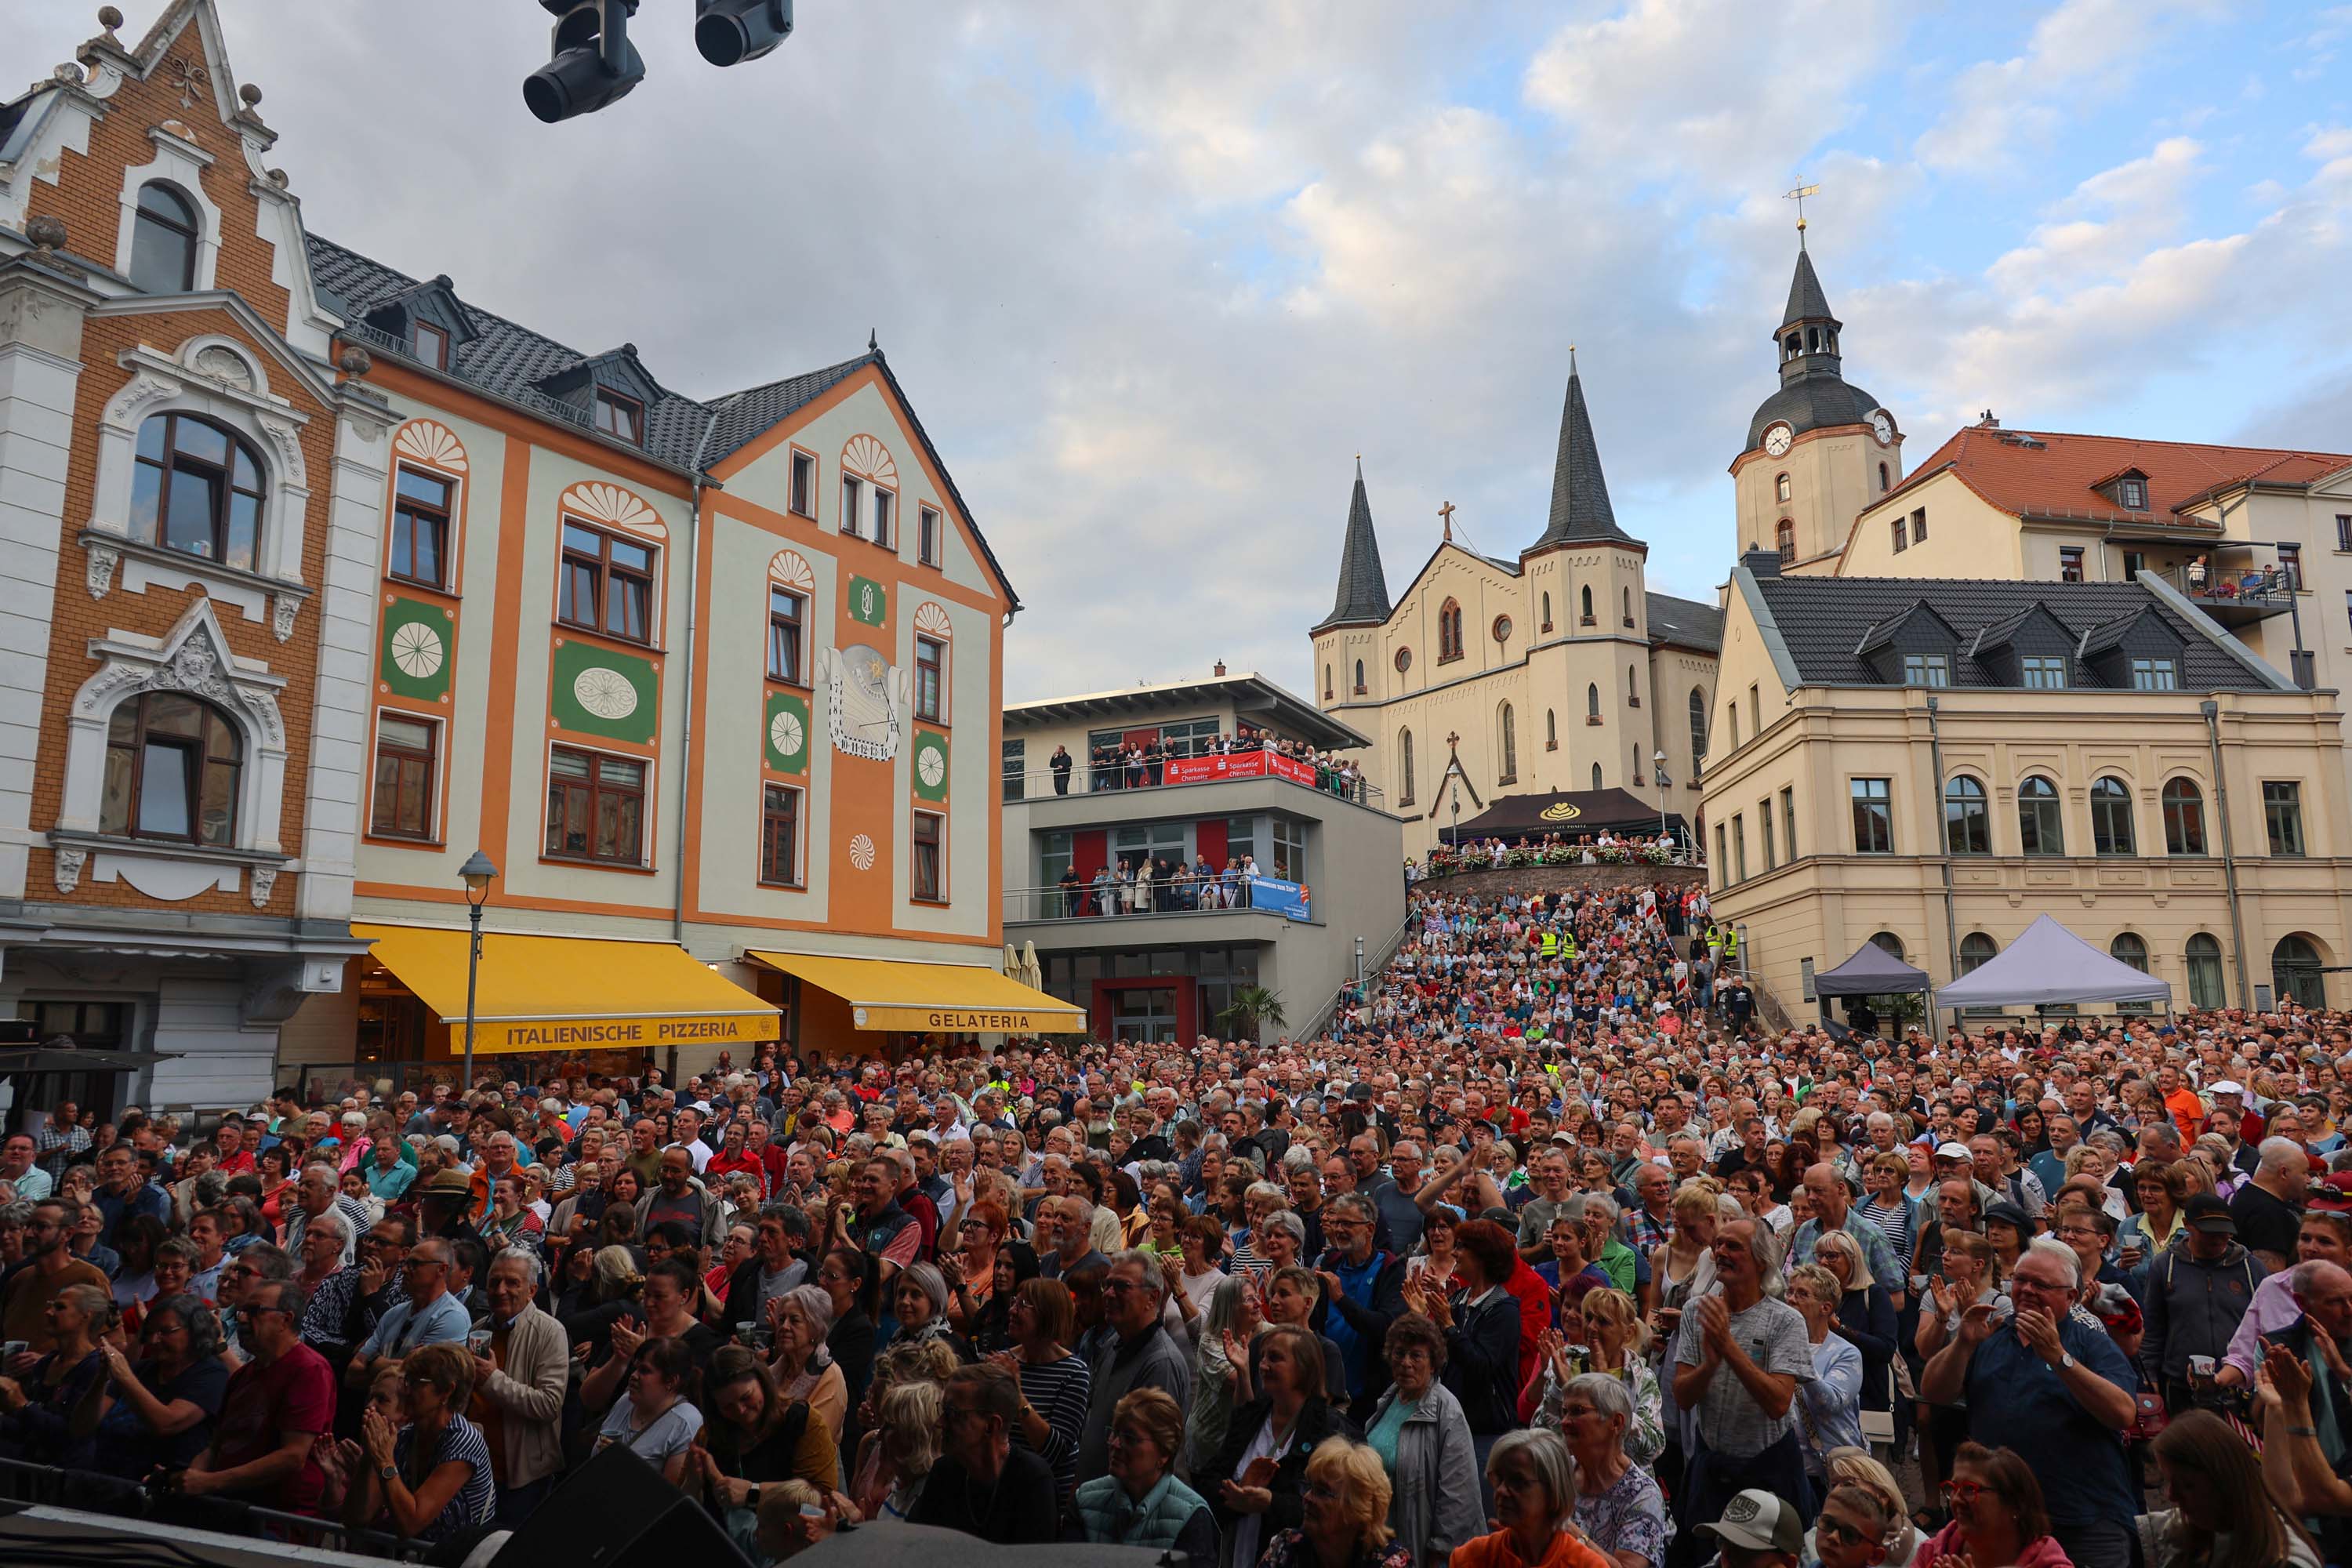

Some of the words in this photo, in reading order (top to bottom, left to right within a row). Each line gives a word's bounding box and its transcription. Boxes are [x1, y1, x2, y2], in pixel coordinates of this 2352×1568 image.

[841, 739, 848, 749] 10
[861, 744, 867, 754] 12
[870, 746, 877, 757] 13
[881, 748, 887, 757] 14
[1181, 766, 1210, 775] Sparkasse
[1229, 760, 1258, 769] Sparkasse
[929, 1013, 1029, 1029] GELATERIA
[506, 1025, 642, 1046] ITALIENISCHE
[659, 1022, 739, 1040] PIZZERIA
